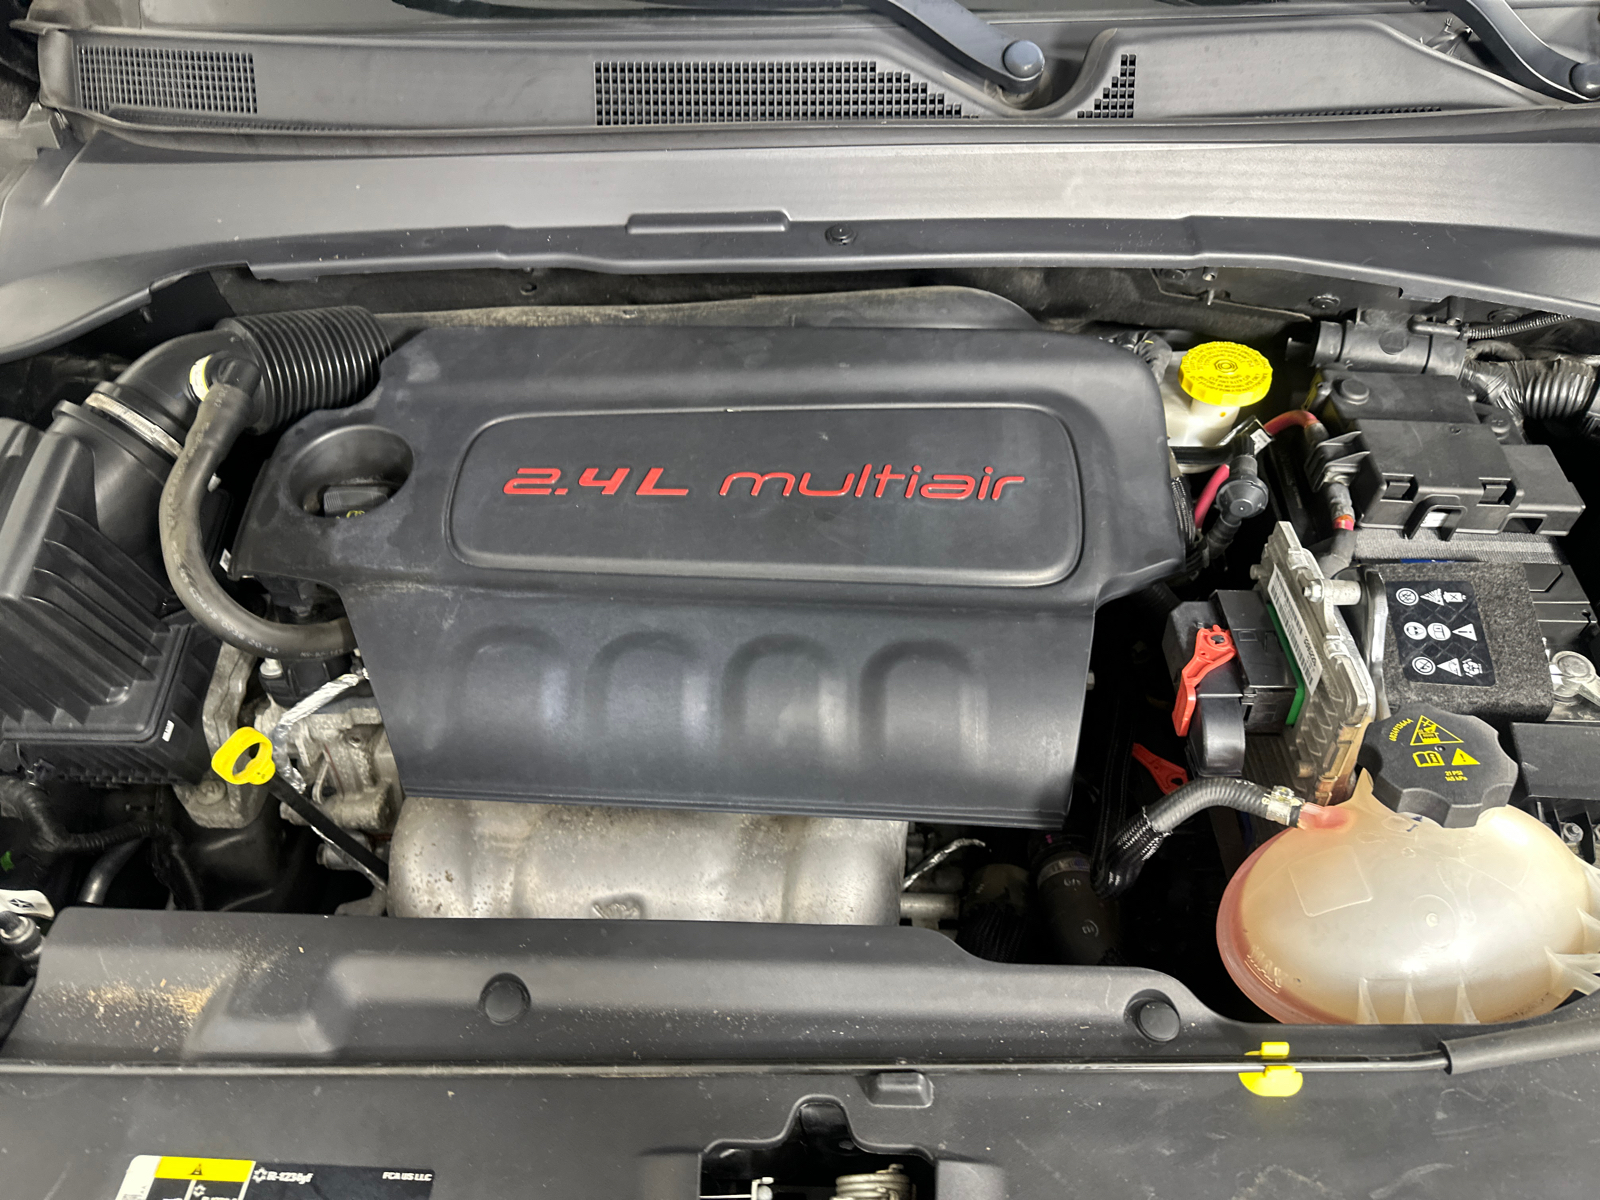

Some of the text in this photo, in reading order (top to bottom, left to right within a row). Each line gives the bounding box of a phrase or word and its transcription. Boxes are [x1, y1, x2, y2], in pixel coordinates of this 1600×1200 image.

[719, 463, 1026, 501] multiair
[1246, 944, 1289, 988] MAX
[382, 1171, 401, 1180] FCA
[401, 1172, 415, 1181] US
[414, 1173, 433, 1182] LLC
